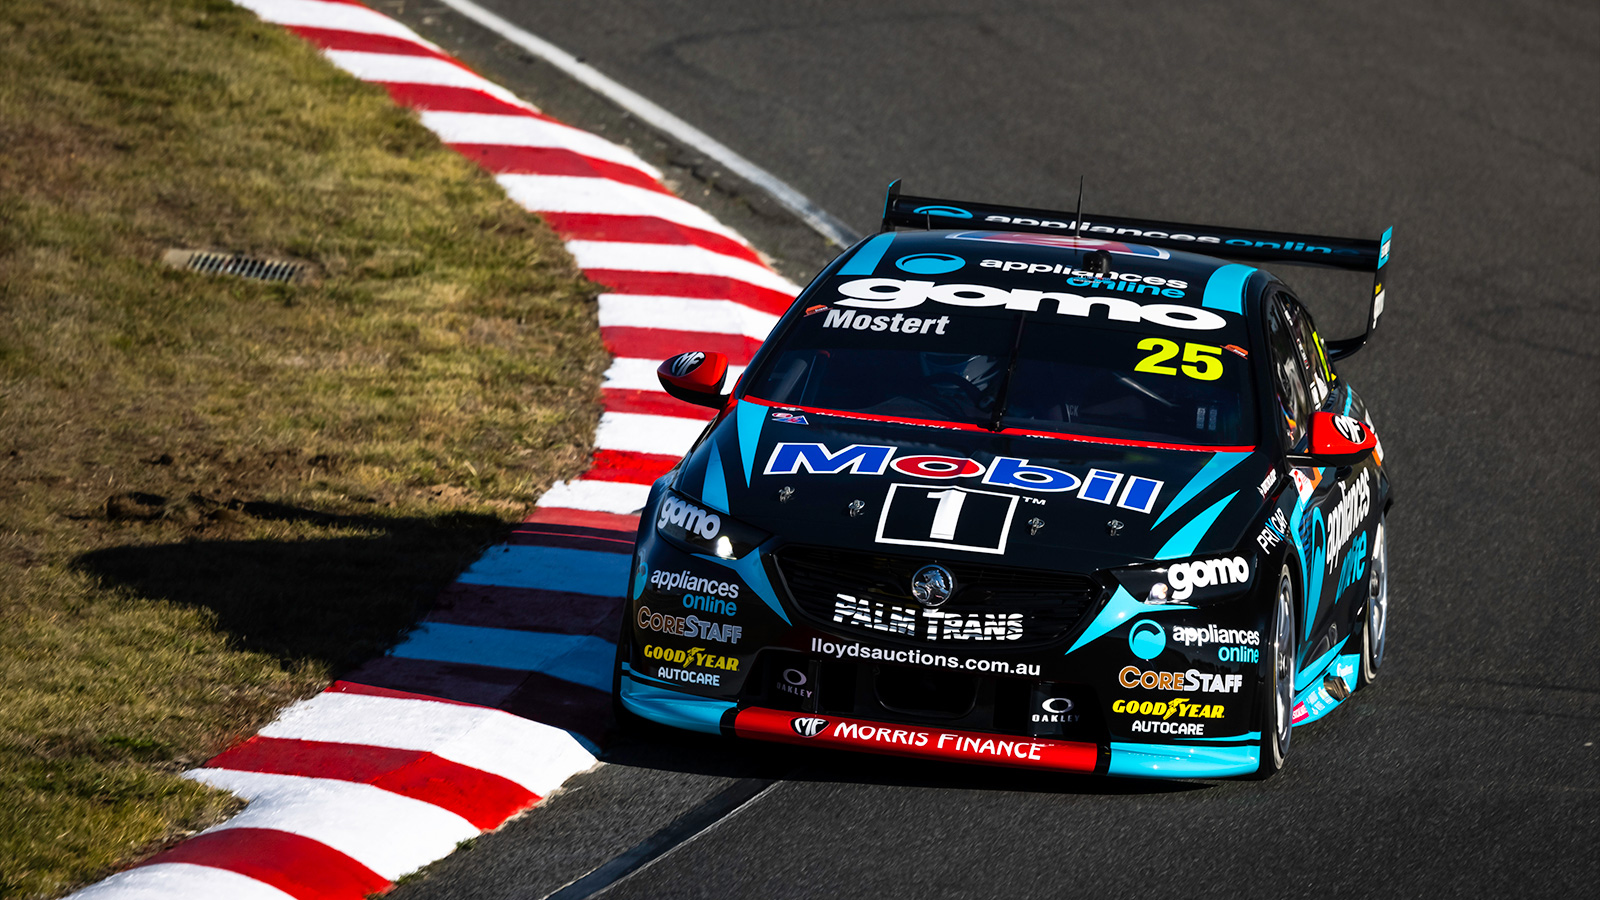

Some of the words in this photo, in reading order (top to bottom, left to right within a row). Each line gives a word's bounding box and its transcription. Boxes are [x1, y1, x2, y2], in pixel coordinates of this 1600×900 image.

[979, 258, 1188, 290] appliances
[1066, 276, 1186, 299] online
[833, 278, 1227, 331] gomo
[823, 308, 951, 336] Mostert
[1134, 337, 1224, 382] 25
[763, 442, 1164, 515] Mobil
[657, 496, 721, 540] gomo
[930, 488, 965, 543] 1
[1326, 466, 1371, 576] appliances
[650, 569, 740, 599] appliances
[1167, 555, 1250, 600] gomo
[682, 593, 738, 617] online
[833, 593, 917, 637] PALM
[922, 608, 1024, 641] TRANS
[1172, 624, 1261, 648] appliances
[811, 637, 1041, 676] lloydsauctions.com.au
[1218, 645, 1260, 665] online
[657, 666, 721, 687] AUTOCARE
[776, 681, 813, 699] OAKLEY
[1031, 713, 1080, 723] OAKLEY
[1131, 719, 1205, 736] AUTOCARE
[833, 722, 928, 748] MORRIS
[936, 733, 1042, 761] FINANCE
